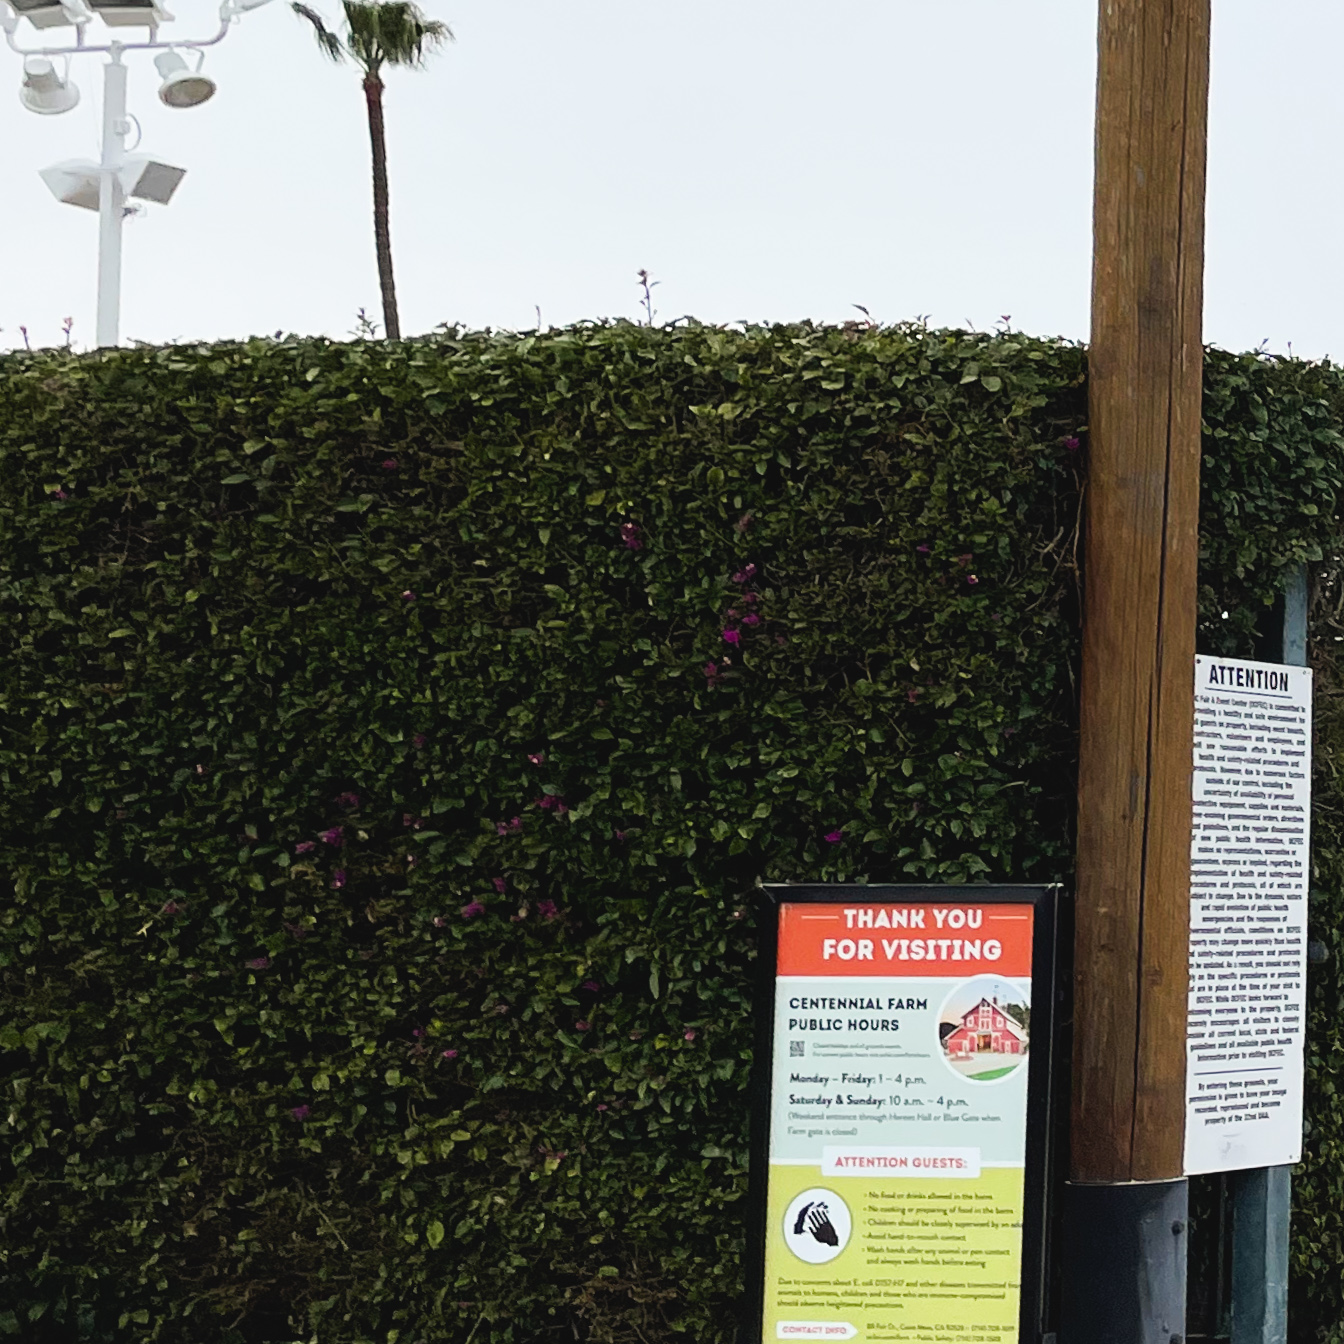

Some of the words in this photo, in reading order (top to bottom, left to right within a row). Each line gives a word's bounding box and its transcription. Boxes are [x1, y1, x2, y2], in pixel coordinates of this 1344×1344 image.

[1209, 664, 1289, 691] ATTENTION
[844, 909, 925, 927] THANK
[933, 909, 981, 928] YOU
[823, 939, 873, 959] FOR
[882, 940, 1001, 959] VISITING
[789, 998, 882, 1009] CENTENNIAL
[888, 998, 927, 1009] FARM
[789, 1019, 842, 1030] PUBLIC
[848, 1019, 898, 1030] HOURS
[790, 1073, 829, 1085] Monday
[842, 1072, 874, 1086] Friday:
[879, 1073, 882, 1083] 1
[895, 1073, 902, 1083] 4
[789, 1093, 832, 1107] Saturday
[836, 1094, 843, 1105] &
[847, 1094, 884, 1107] Sunday:
[889, 1094, 901, 1106] 10
[937, 1095, 943, 1105] 4
[835, 1157, 907, 1167] ATTENTION
[912, 1158, 967, 1168] GUESTS:
